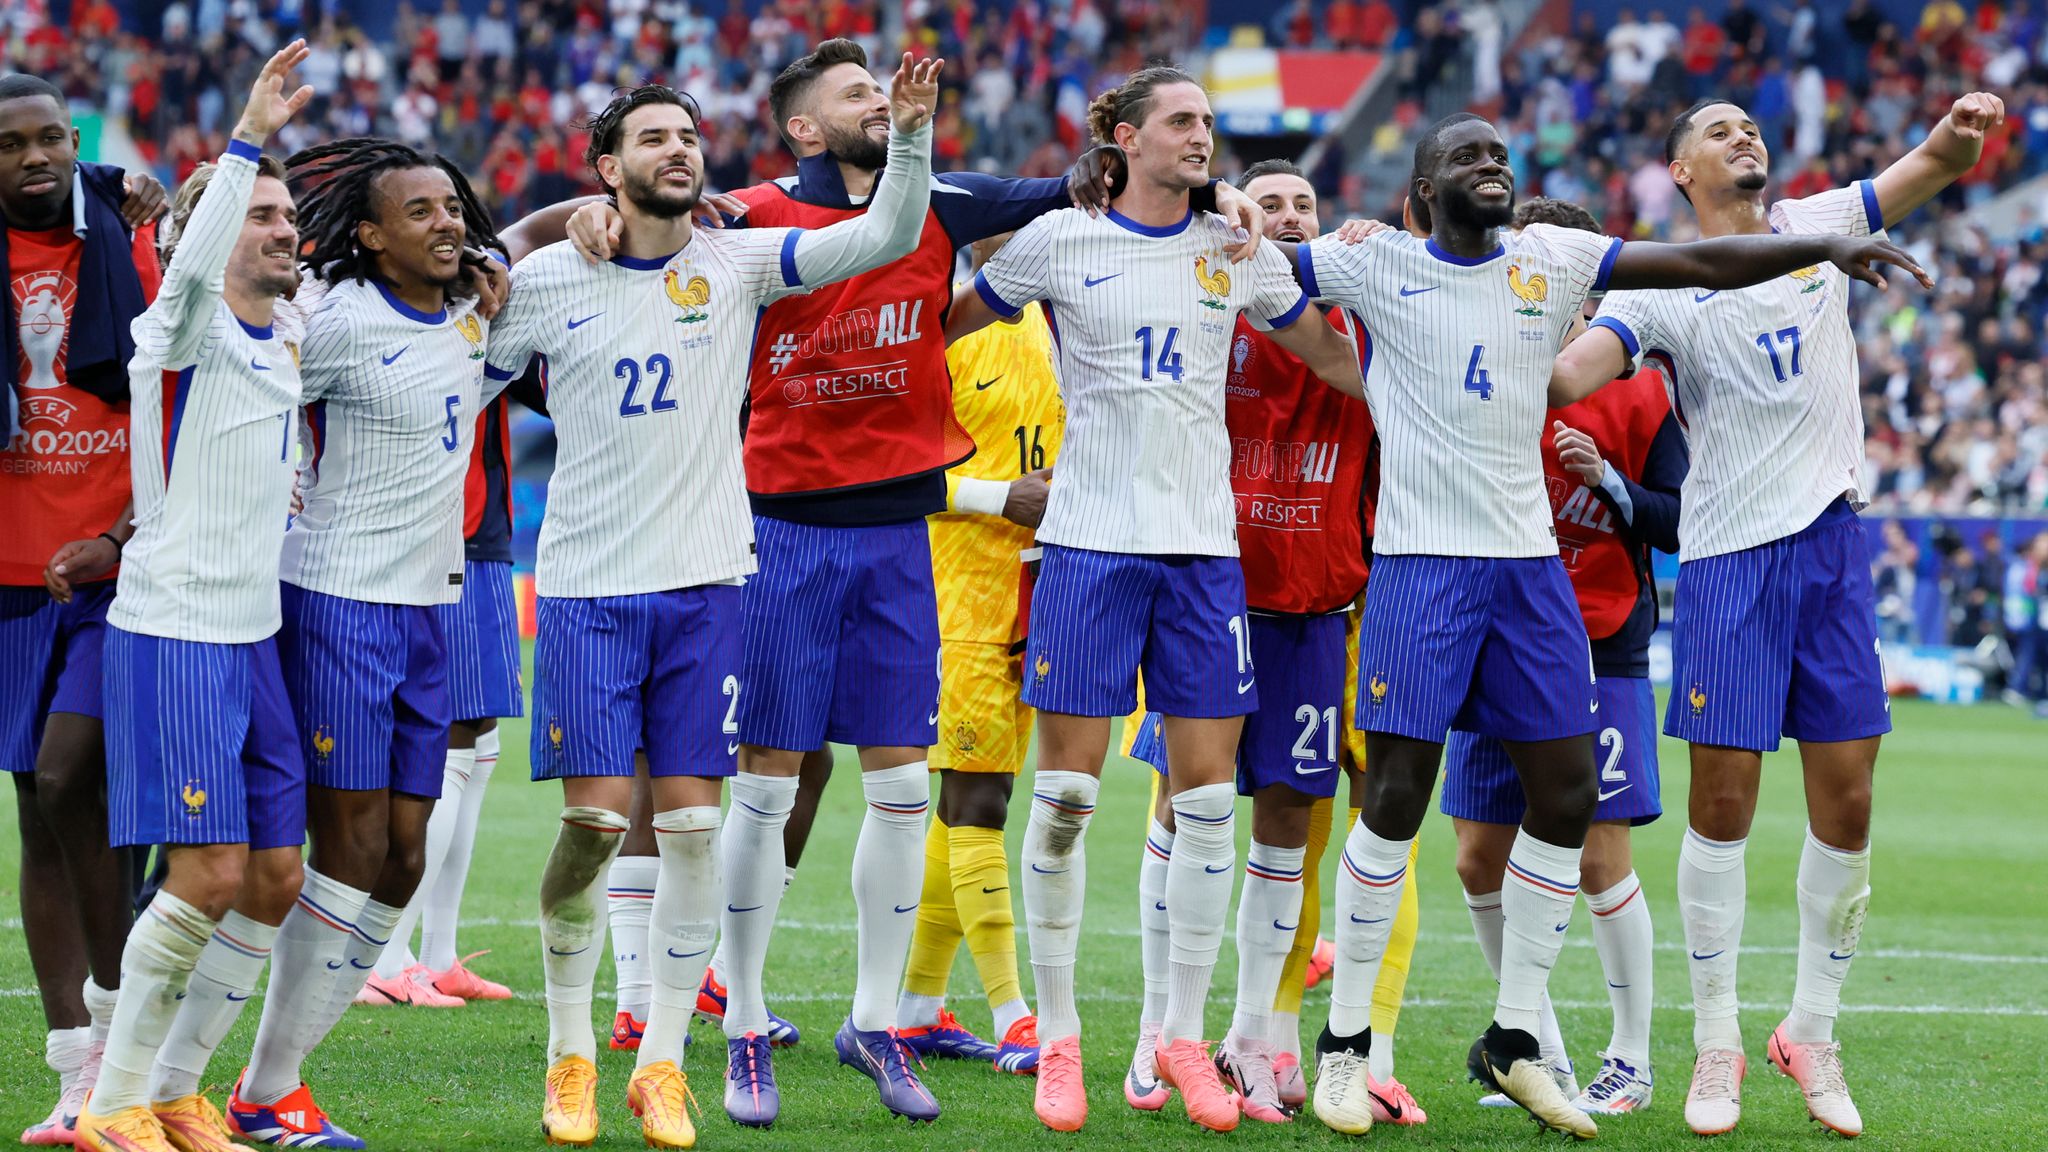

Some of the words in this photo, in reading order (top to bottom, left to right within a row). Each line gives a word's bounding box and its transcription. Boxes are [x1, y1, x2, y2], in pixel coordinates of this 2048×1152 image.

[815, 367, 908, 397] RESPECT
[1135, 326, 1185, 383] 14
[1464, 345, 1494, 401] 4
[1756, 326, 1804, 383] 17
[614, 353, 679, 418] 22
[1226, 385, 1260, 398] RO2024
[9, 428, 127, 455] RO2024
[441, 394, 461, 454] 5
[1014, 425, 1045, 477] 16
[2, 459, 90, 475] GERMANY
[722, 674, 742, 734] 2
[1291, 703, 1338, 762] 21
[1600, 727, 1627, 781] 2
